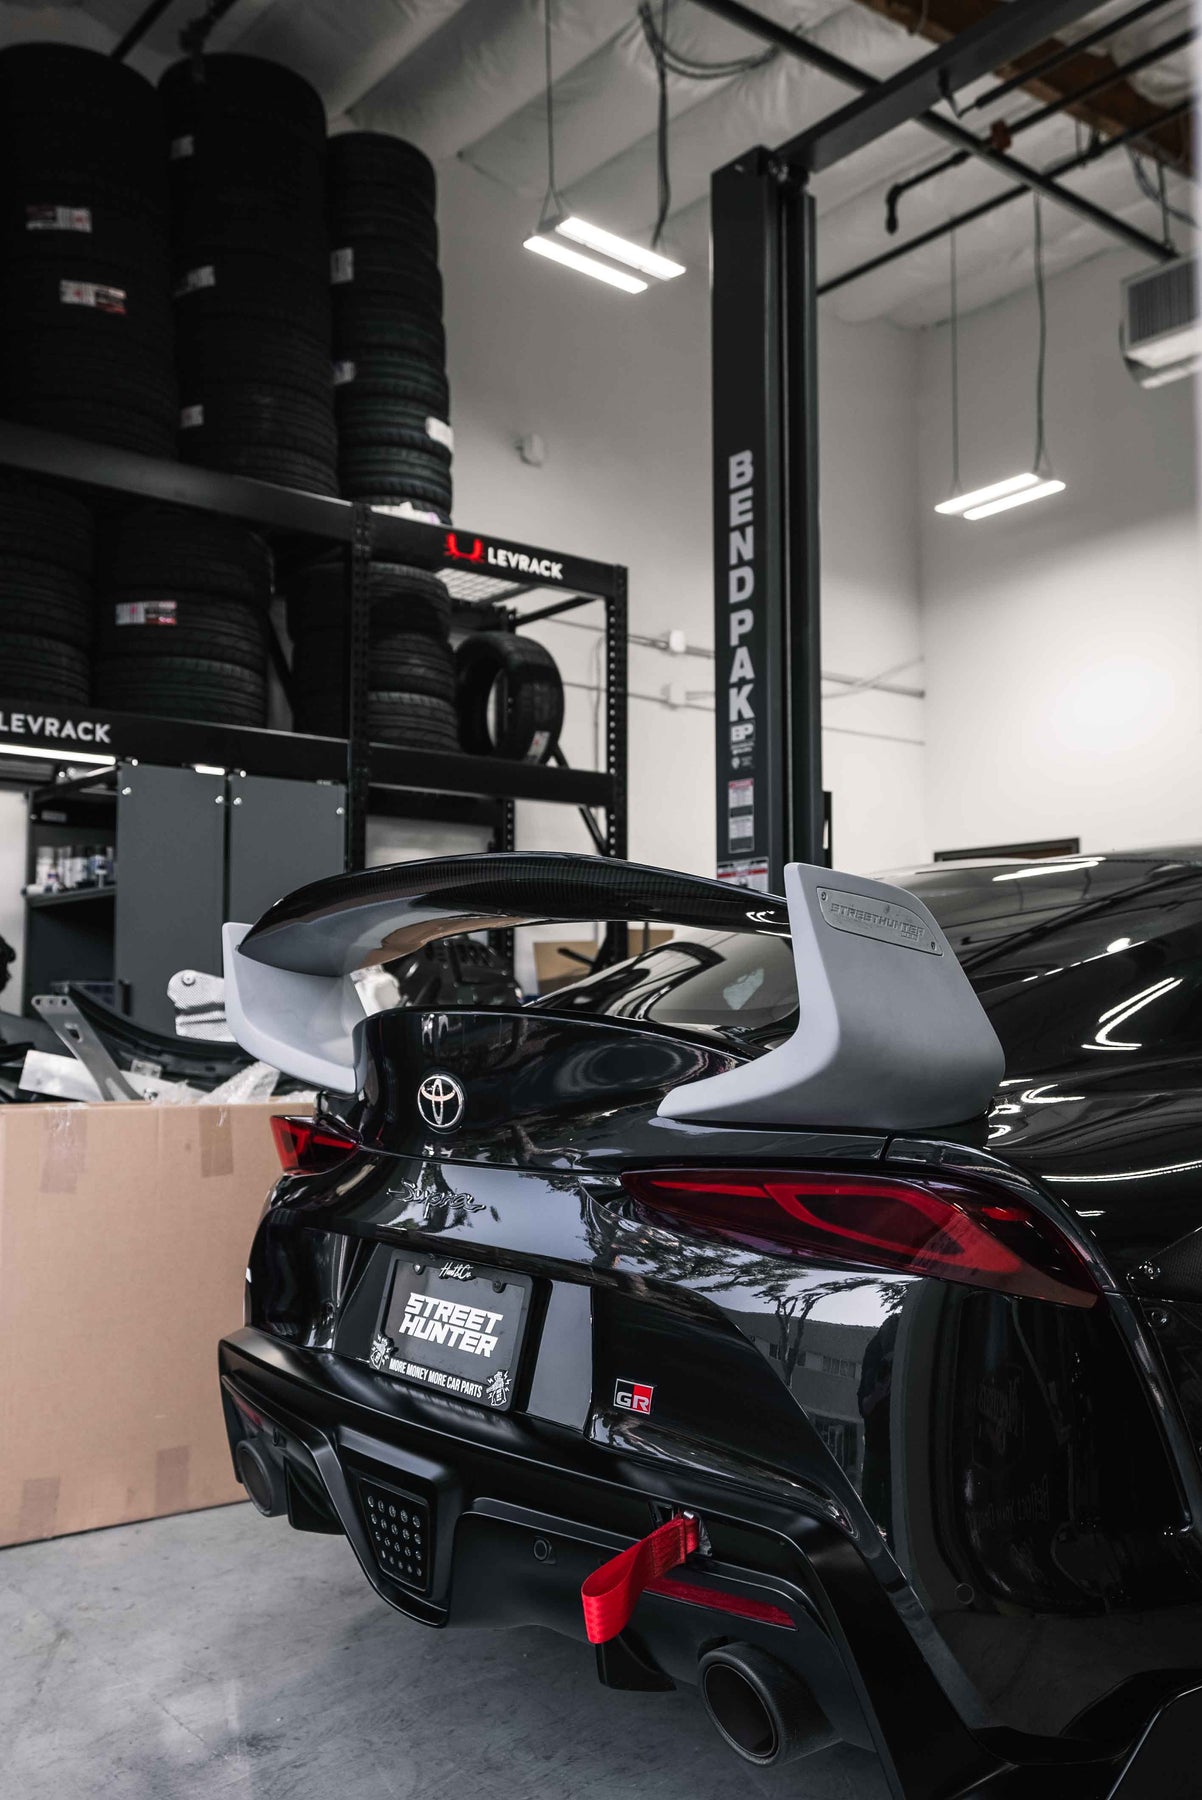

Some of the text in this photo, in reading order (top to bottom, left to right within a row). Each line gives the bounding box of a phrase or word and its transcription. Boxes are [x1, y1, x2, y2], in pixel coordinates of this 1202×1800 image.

[487, 546, 563, 580] LEVRACK
[0, 711, 111, 743] LEVRACK
[731, 723, 754, 742] BP
[404, 1292, 504, 1334] STREET
[399, 1313, 498, 1357] HUNTER
[389, 1358, 483, 1398] MORE MONEY MORE CAR PARTS
[616, 1391, 650, 1411] GR
